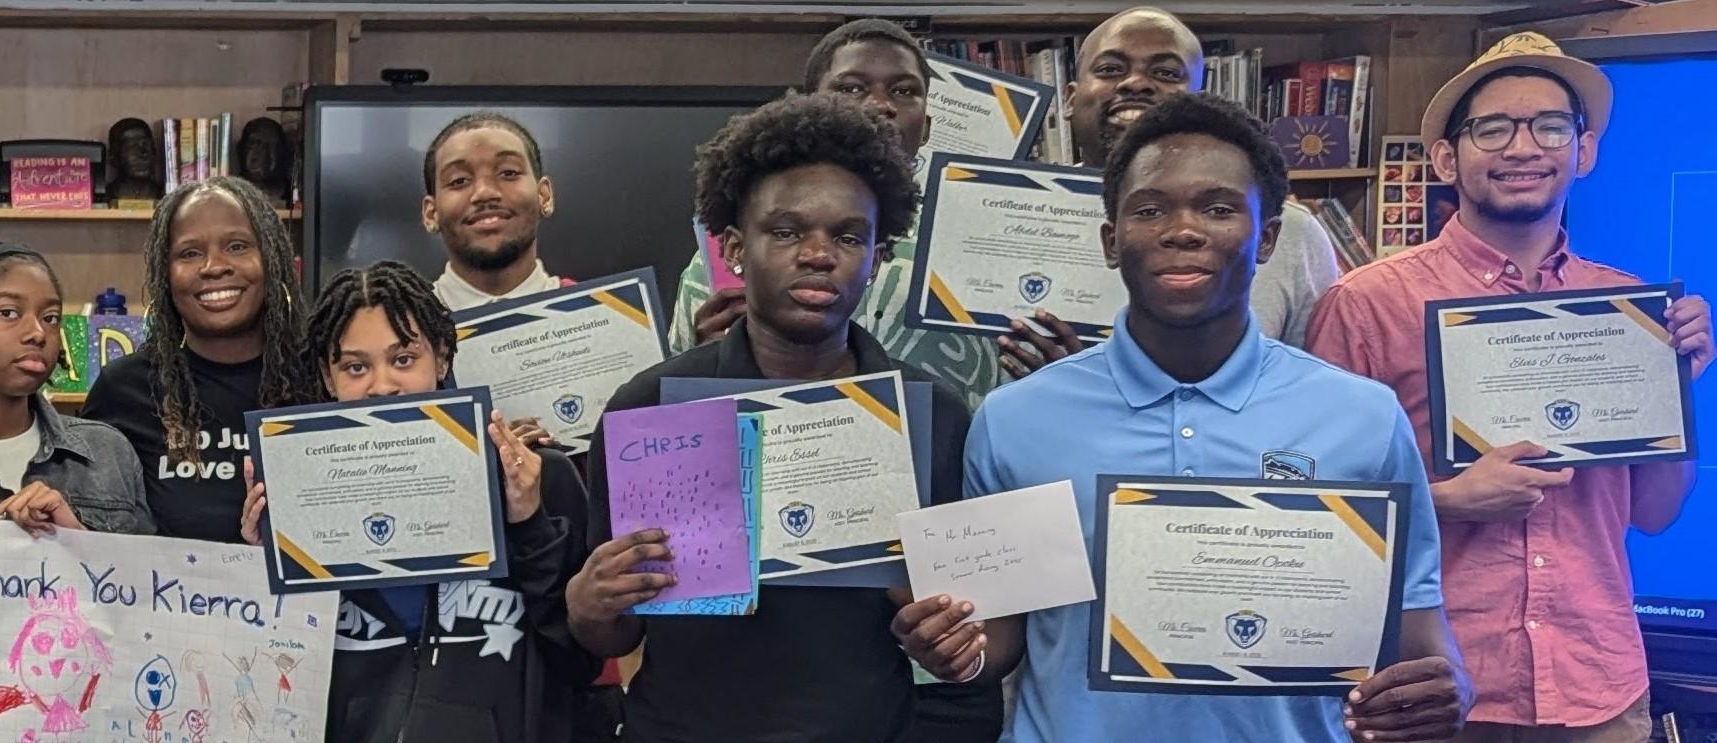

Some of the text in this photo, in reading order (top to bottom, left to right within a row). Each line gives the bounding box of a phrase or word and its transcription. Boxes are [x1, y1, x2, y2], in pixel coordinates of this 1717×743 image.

[937, 94, 991, 116] Appreciation
[14, 158, 54, 168] READING
[70, 157, 86, 167] AN
[15, 193, 35, 201] THAT
[39, 192, 66, 201] NEVER
[982, 198, 1033, 212] Certificate
[1035, 204, 1046, 212] of
[491, 336, 538, 354] Certificate
[540, 330, 549, 341] of
[551, 317, 610, 339] Appreciation
[1488, 334, 1541, 346] Certificate
[1544, 331, 1555, 341] of
[1557, 326, 1625, 341] Appreciation
[771, 416, 855, 435] of Appreciation
[305, 443, 356, 457] Certificate
[359, 441, 370, 451] of
[371, 435, 436, 450] Appreciation
[619, 434, 703, 461] CHRIS
[159, 455, 235, 480] Love
[1166, 522, 1334, 540] Certificate of Appreciation
[1191, 551, 1259, 567] Emmanuel
[80, 562, 136, 606] You
[1671, 606, 1686, 617] Pro
[1687, 608, 1705, 619] (27)
